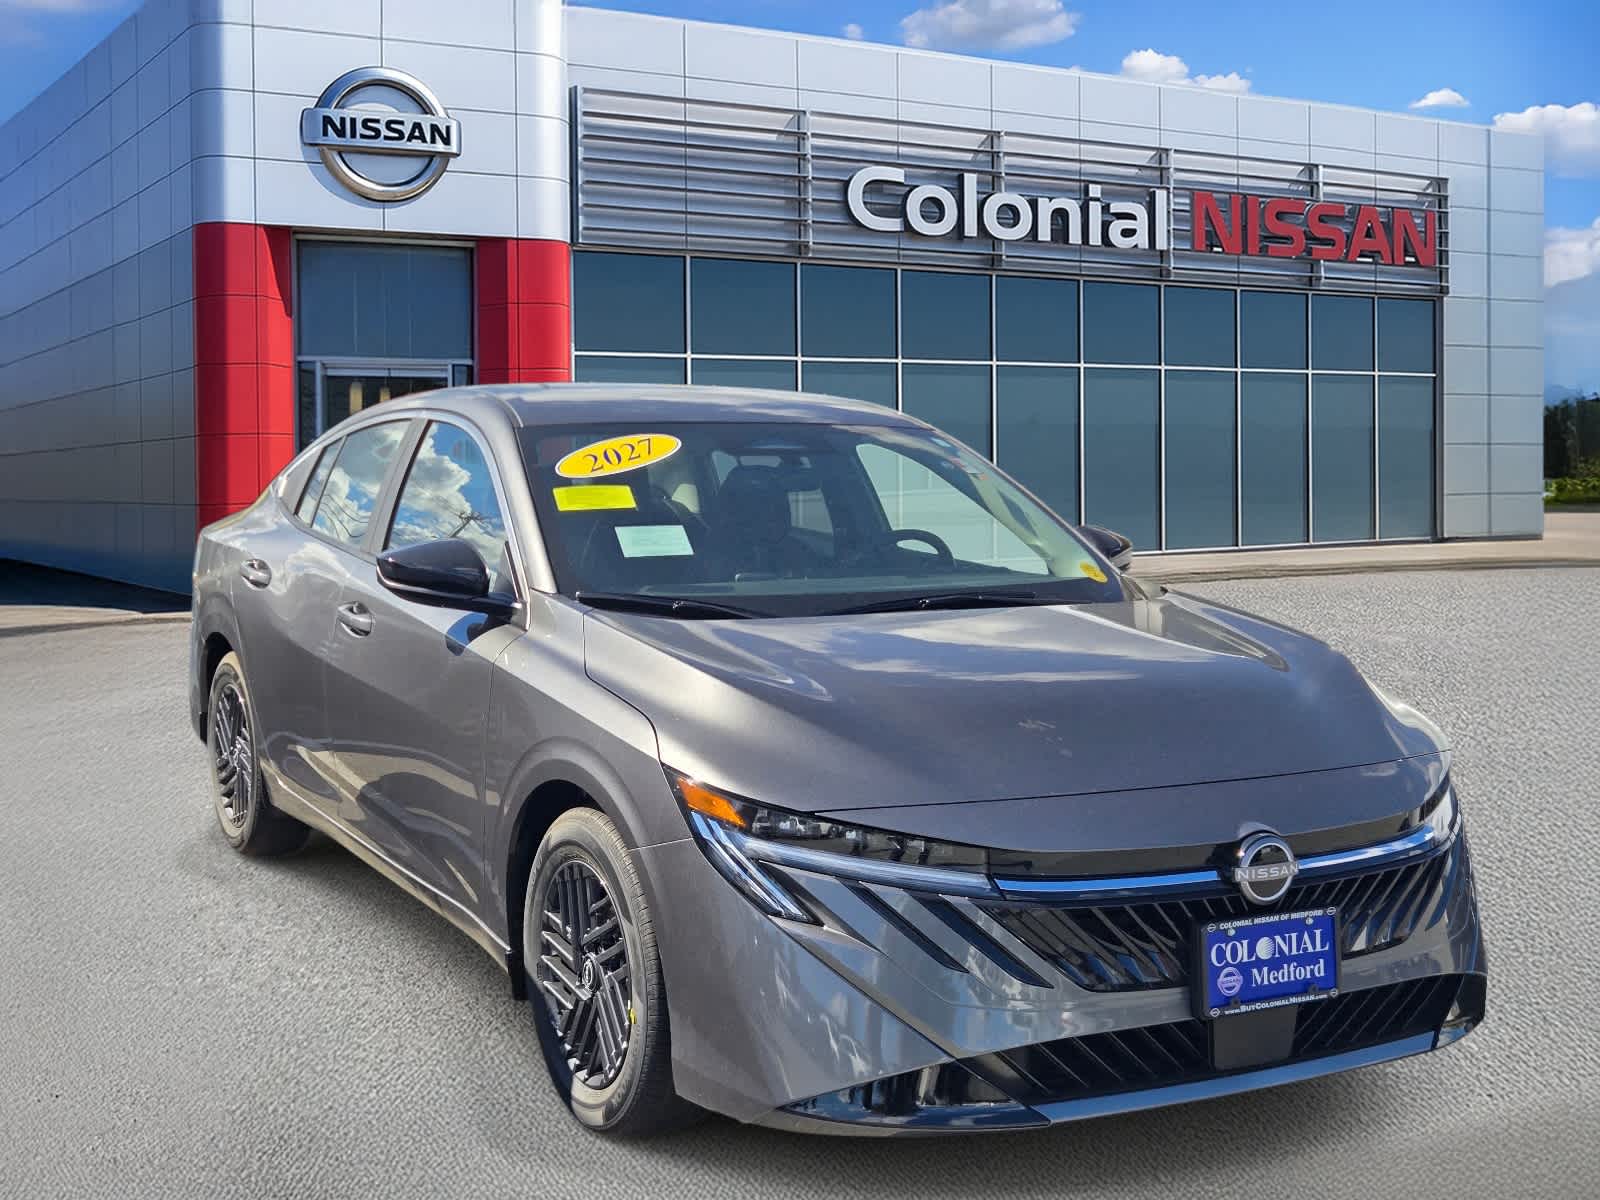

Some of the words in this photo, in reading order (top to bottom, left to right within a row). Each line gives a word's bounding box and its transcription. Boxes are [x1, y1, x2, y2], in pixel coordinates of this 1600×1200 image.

[321, 115, 451, 146] NISSAN
[846, 165, 1168, 250] Colonial
[1191, 190, 1436, 267] NISSAN
[583, 438, 652, 473] 2027
[1237, 863, 1298, 881] NISSAN
[1280, 912, 1290, 921] OF
[1210, 929, 1329, 967] COLONIAL
[1251, 958, 1325, 987] Medford
